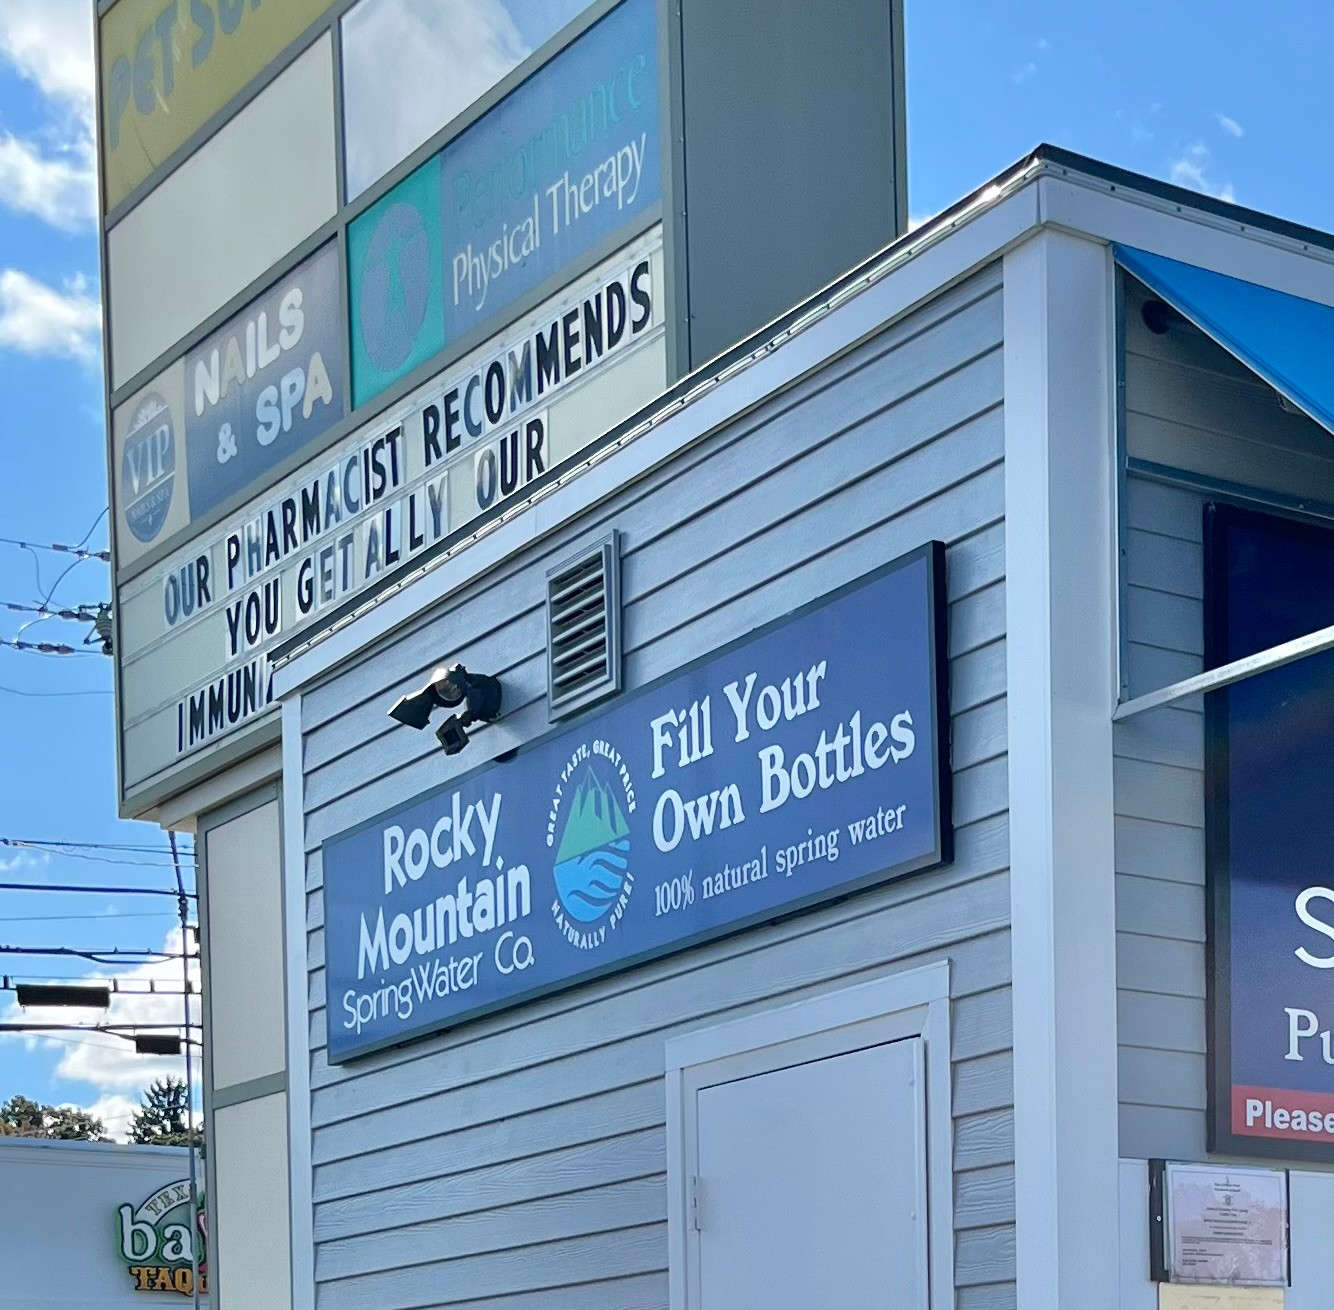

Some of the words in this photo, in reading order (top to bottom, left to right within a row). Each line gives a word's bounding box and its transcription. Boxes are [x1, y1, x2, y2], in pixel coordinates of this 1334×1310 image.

[453, 193, 541, 311] Physical
[546, 132, 647, 235] Therapy
[194, 288, 304, 416] NAILS
[216, 422, 238, 464] &
[255, 352, 333, 446] SPA
[126, 424, 170, 495] VIP
[164, 555, 211, 626] OUR
[227, 427, 402, 590] PHARMACIST
[422, 261, 651, 467] RECOMMENDS
[226, 577, 279, 656] YOU
[298, 534, 354, 614] GET
[477, 418, 546, 511] OUR
[178, 656, 273, 751] IMMUNI
[650, 695, 714, 779] Fill
[723, 660, 827, 743] Your
[546, 784, 563, 847] GREAT
[561, 744, 590, 783] TASTE,
[592, 739, 622, 767] GREAT
[619, 764, 637, 813] PRICE
[653, 783, 746, 853] Own
[758, 709, 916, 814] Bottles
[384, 791, 502, 895] Rocky
[655, 869, 695, 917] 100%
[702, 845, 768, 900] natural
[775, 829, 839, 877] spring
[848, 804, 907, 846] water
[358, 855, 531, 980] Mountain
[551, 899, 606, 950] NATURALLY
[609, 872, 635, 930] PURE!
[343, 952, 484, 1034] SpringWater
[495, 931, 535, 974] Co.
